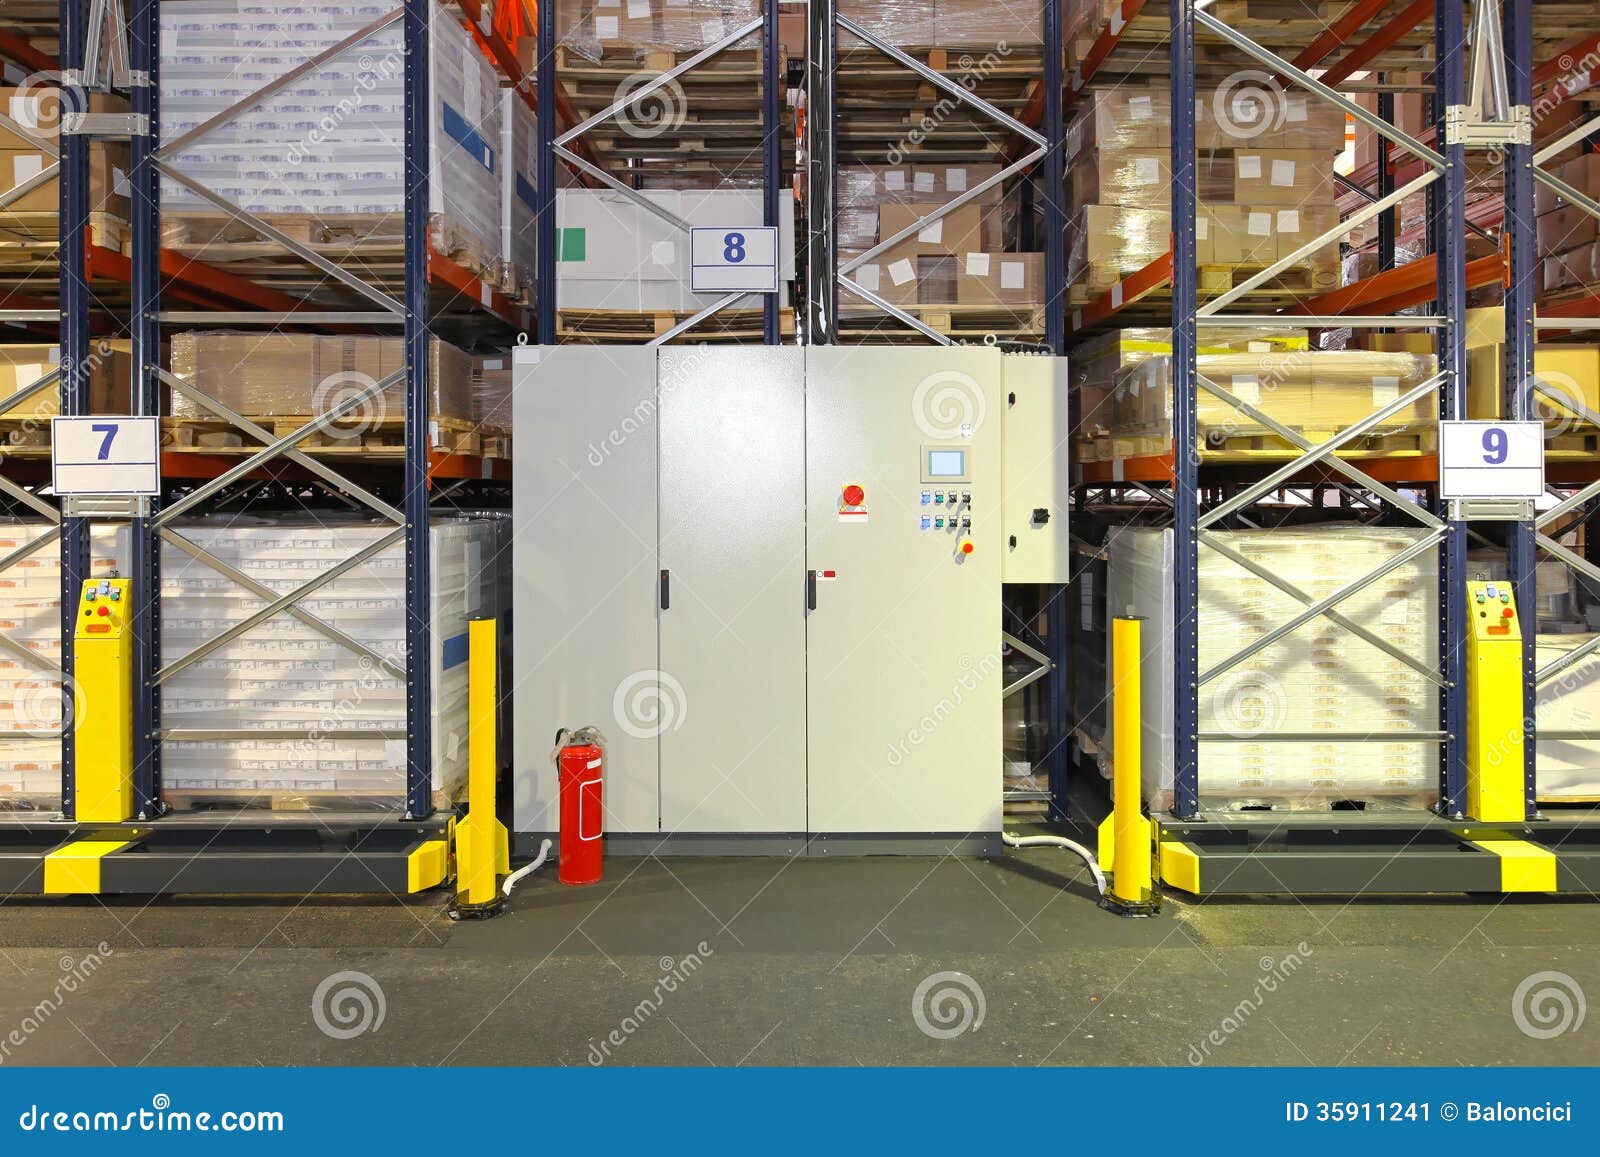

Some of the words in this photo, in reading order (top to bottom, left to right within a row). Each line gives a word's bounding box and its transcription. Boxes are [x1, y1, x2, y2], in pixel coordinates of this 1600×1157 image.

[724, 233, 745, 262] 8
[92, 424, 117, 459] 7
[1482, 428, 1507, 463] 9
